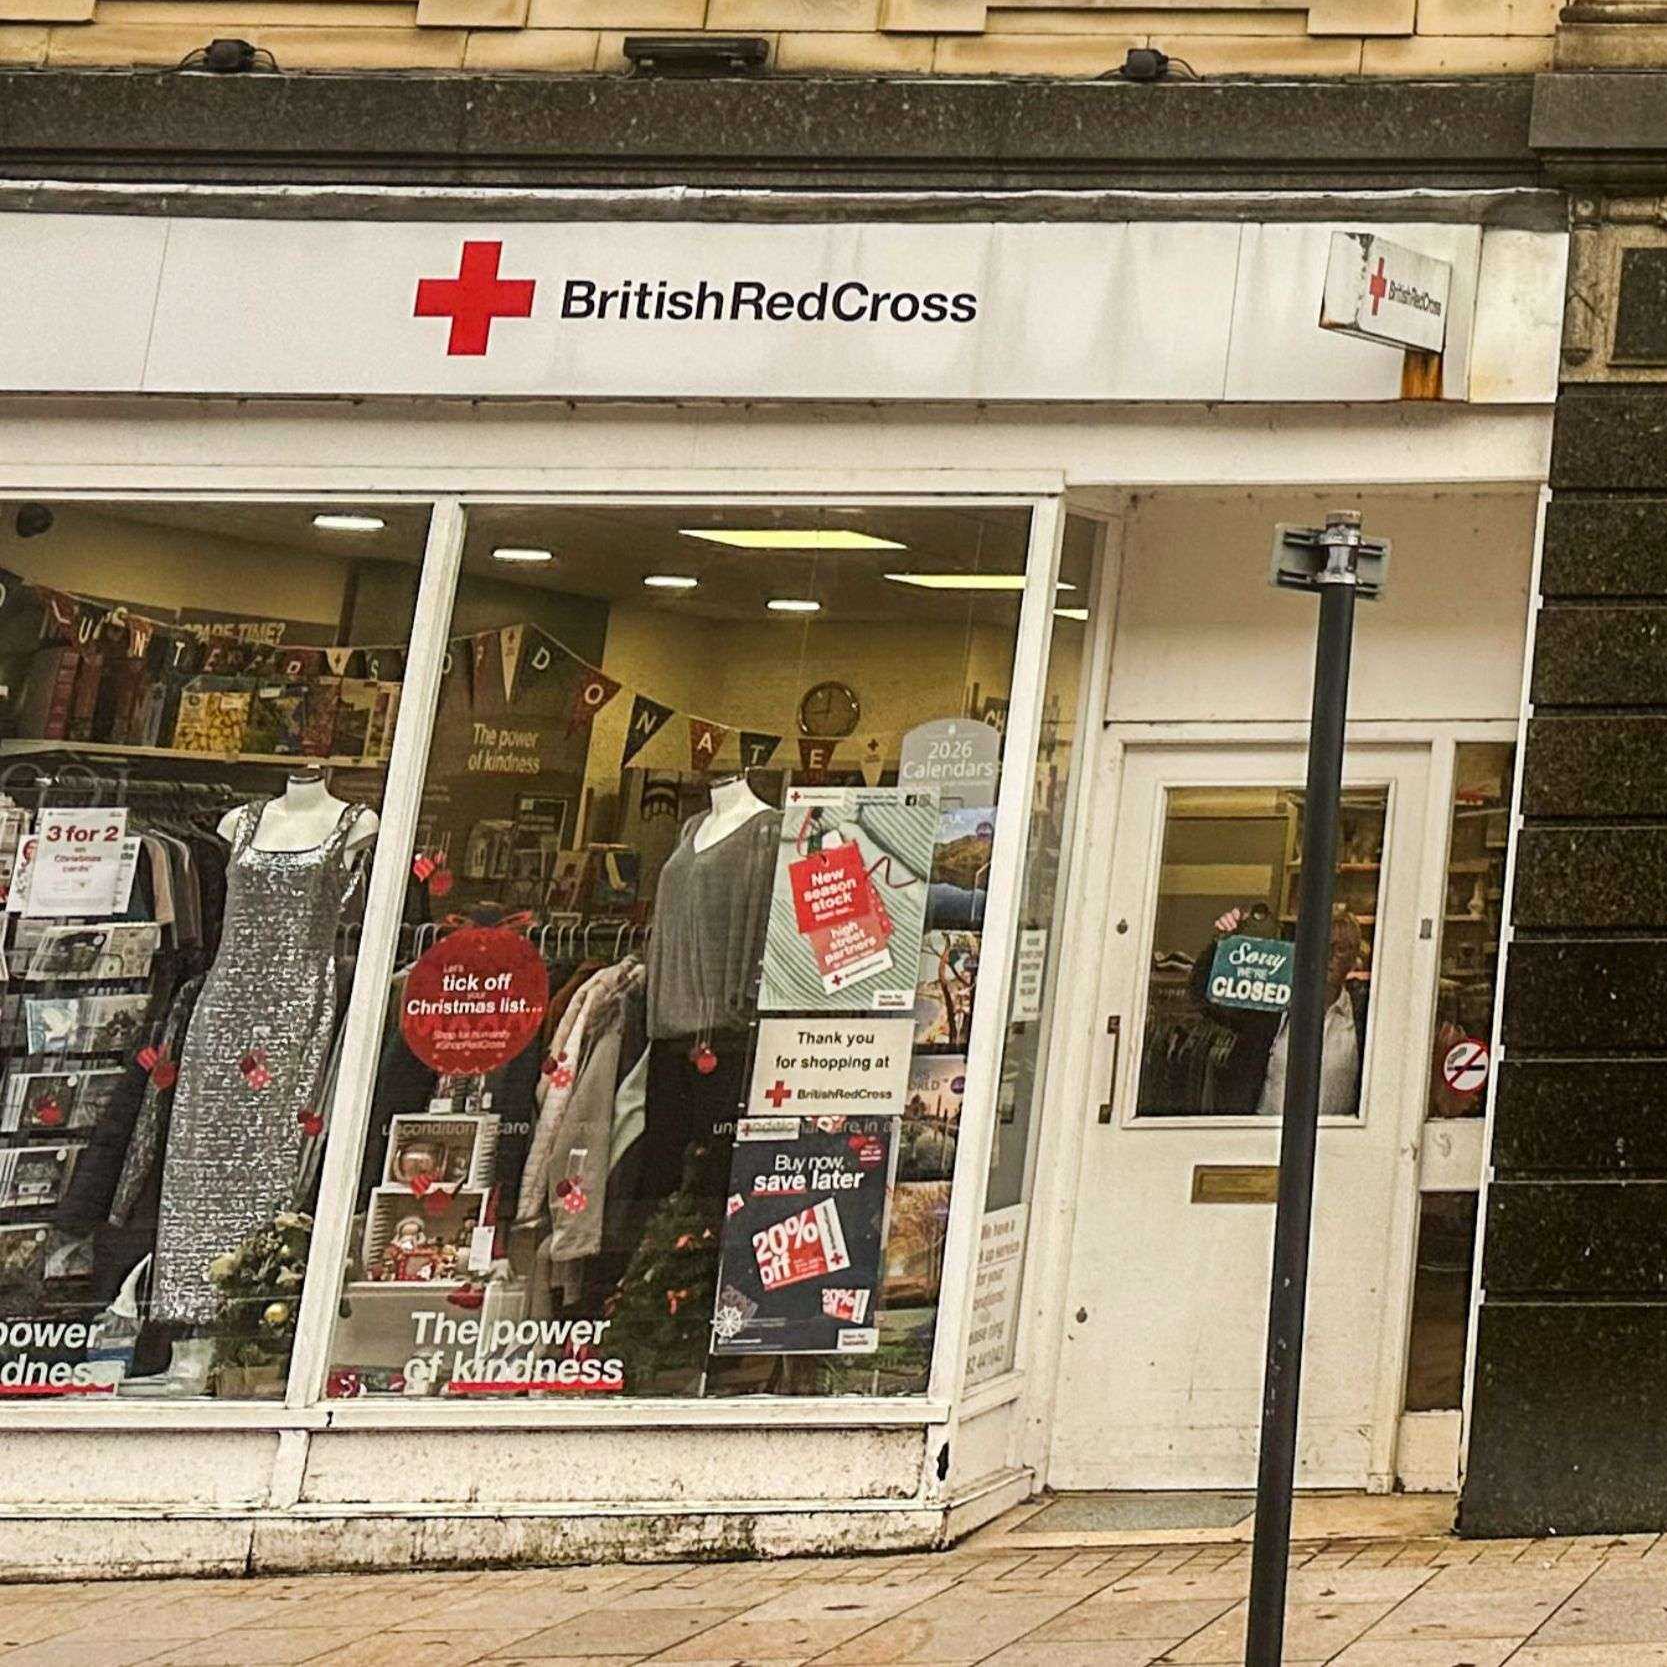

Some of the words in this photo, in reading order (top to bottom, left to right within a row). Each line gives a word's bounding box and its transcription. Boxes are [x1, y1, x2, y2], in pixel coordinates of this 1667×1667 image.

[560, 279, 978, 323] BritishRedCross
[473, 722, 496, 746] The
[498, 728, 539, 750] power
[468, 750, 482, 771] of
[481, 748, 541, 774] kindness
[927, 740, 973, 760] 2026
[902, 761, 995, 780] Calendars
[46, 826, 62, 842] 3
[66, 825, 101, 842] for
[103, 825, 119, 842] 2
[810, 868, 845, 887] New
[803, 878, 857, 903] season
[810, 891, 853, 914] stock
[824, 936, 877, 967] partners
[1228, 942, 1287, 976] Sorry
[442, 973, 480, 992] tick
[484, 973, 513, 991] off
[1211, 976, 1292, 1005] CLOSED
[406, 998, 496, 1016] Christmas
[797, 1031, 842, 1045] Thank
[846, 1034, 876, 1047] you
[775, 1055, 796, 1069] for
[800, 1055, 871, 1072] shopping
[874, 1056, 890, 1069] at
[796, 1088, 893, 1101] BritishRedCross
[775, 1154, 806, 1173] Buy
[753, 1173, 806, 1192] save
[811, 1169, 865, 1190] later
[752, 1210, 819, 1264] 20%
[760, 1251, 791, 1286] off
[410, 1311, 481, 1346] The
[491, 1317, 611, 1355] power
[403, 1355, 444, 1383] of
[452, 1354, 625, 1383] kindness
